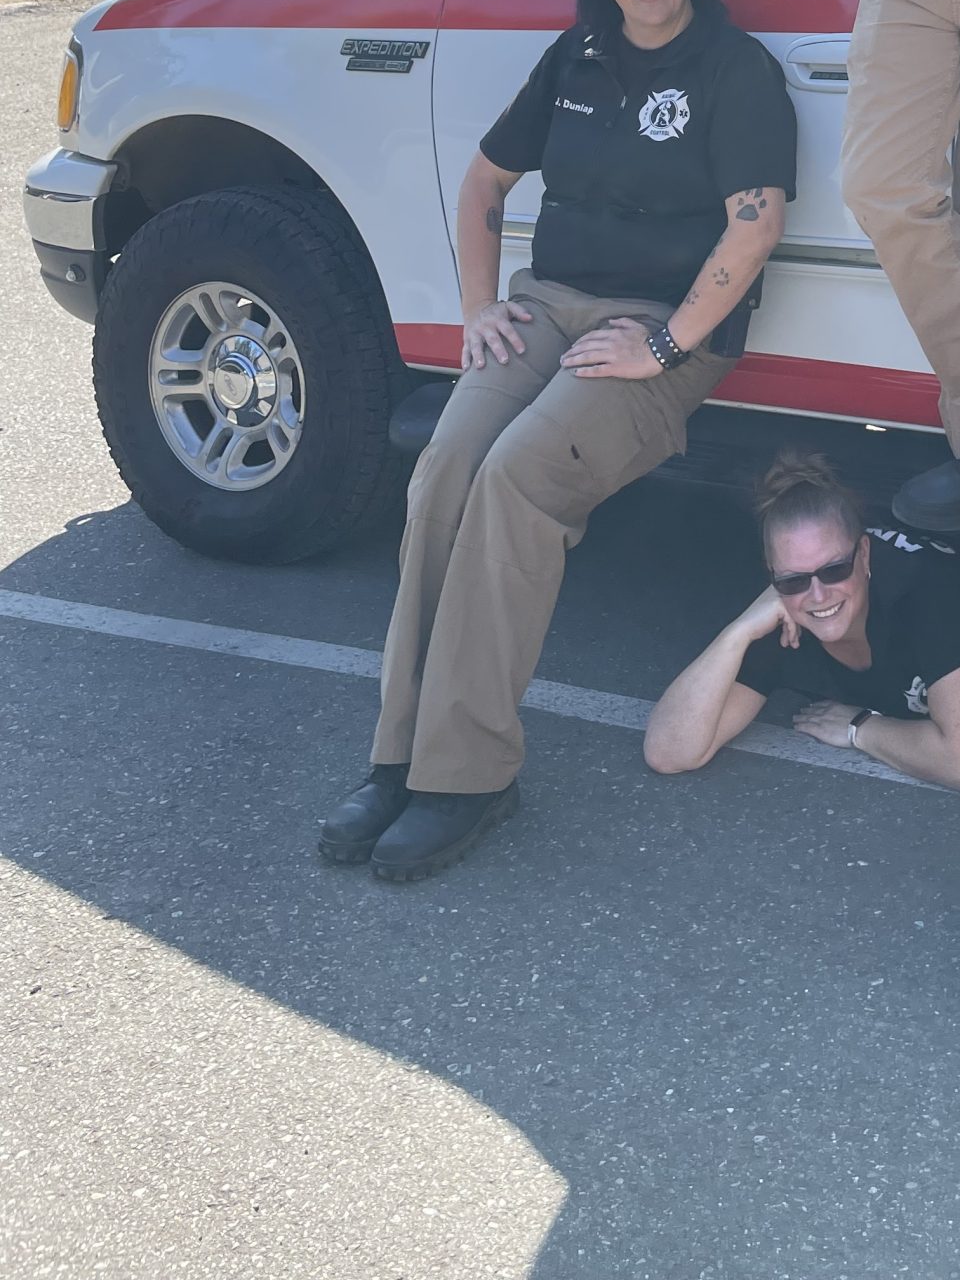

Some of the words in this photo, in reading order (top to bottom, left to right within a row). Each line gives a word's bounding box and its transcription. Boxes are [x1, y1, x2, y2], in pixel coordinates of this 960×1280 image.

[341, 40, 426, 57] EXPEDITION
[554, 96, 561, 107] J.
[562, 99, 594, 115] Dunlap
